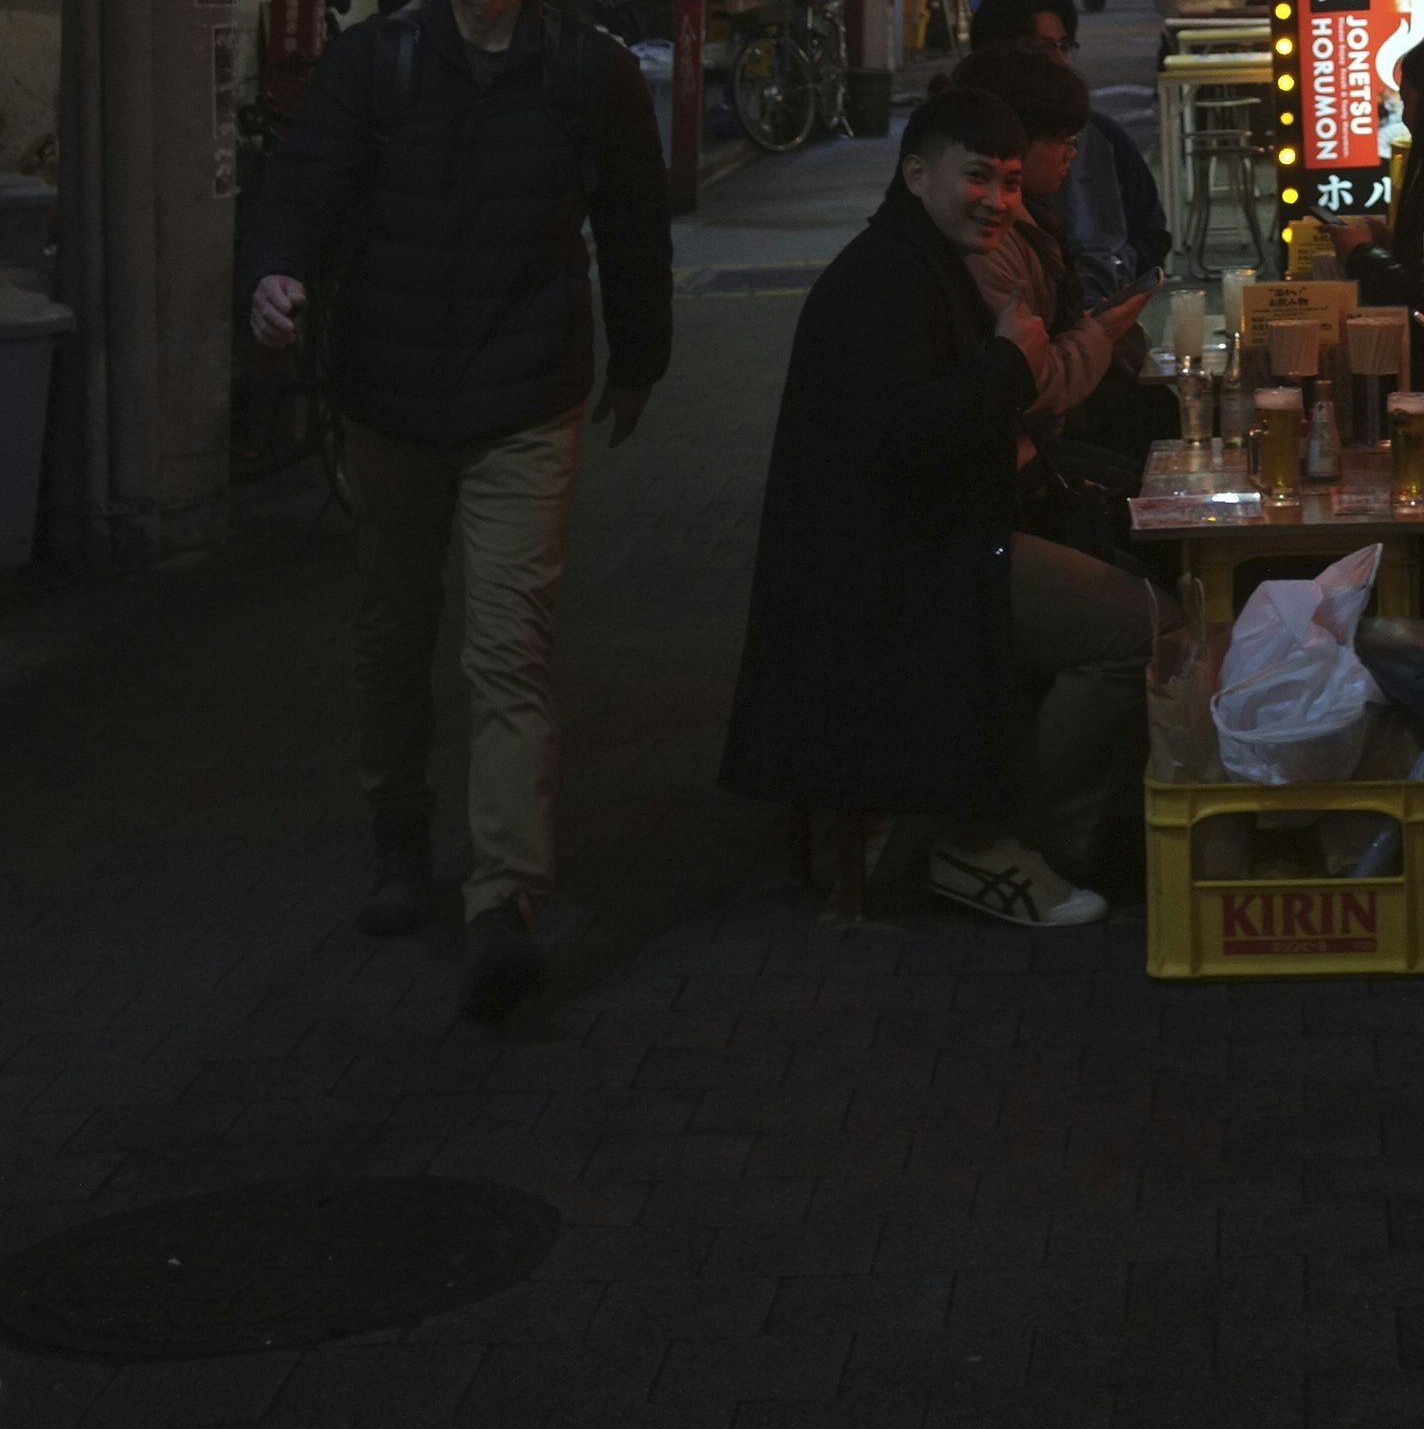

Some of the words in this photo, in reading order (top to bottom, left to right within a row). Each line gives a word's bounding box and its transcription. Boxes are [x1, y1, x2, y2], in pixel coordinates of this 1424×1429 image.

[1311, 17, 1339, 160] HORUMON
[1346, 14, 1374, 135] JONETSU
[1222, 892, 1377, 937] KIRIN
